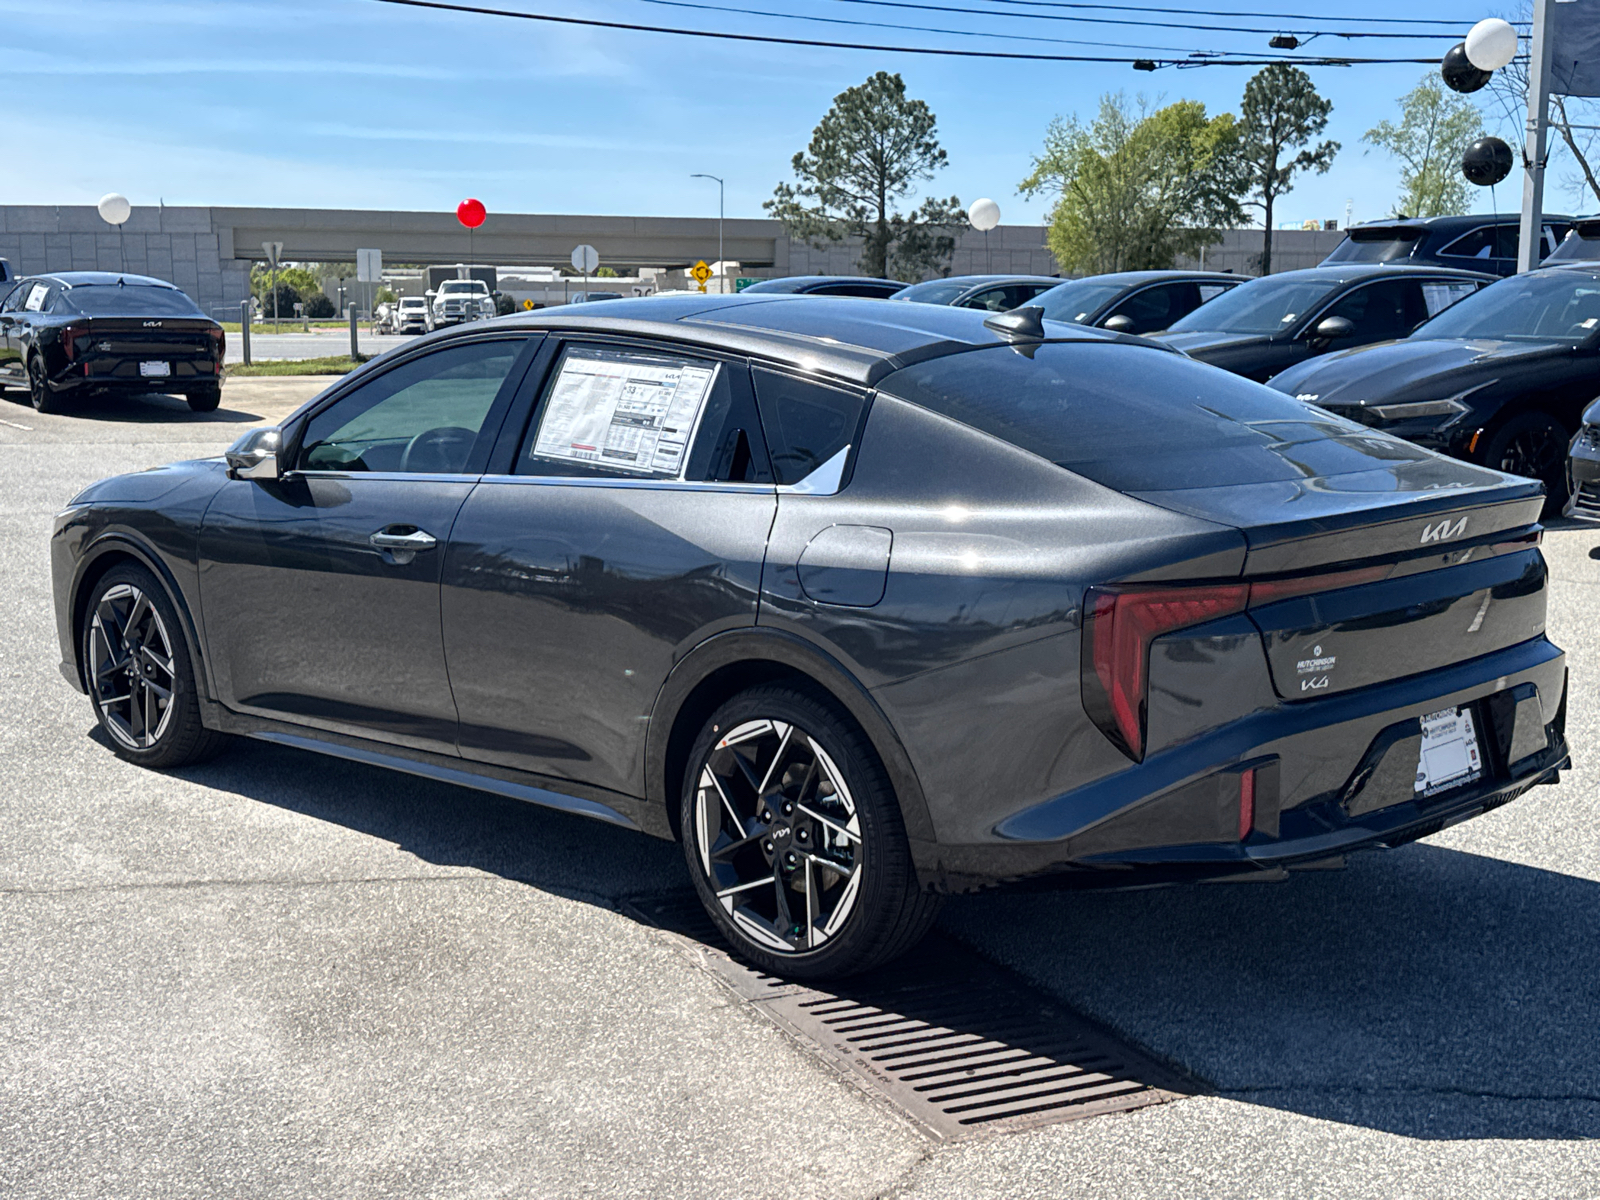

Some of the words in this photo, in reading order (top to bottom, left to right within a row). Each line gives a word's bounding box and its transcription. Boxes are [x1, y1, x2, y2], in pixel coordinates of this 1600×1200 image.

[1420, 516, 1468, 543] KIA
[1297, 656, 1336, 669] HUTCHINSON
[1301, 675, 1329, 690] K4
[772, 827, 790, 840] KIA
